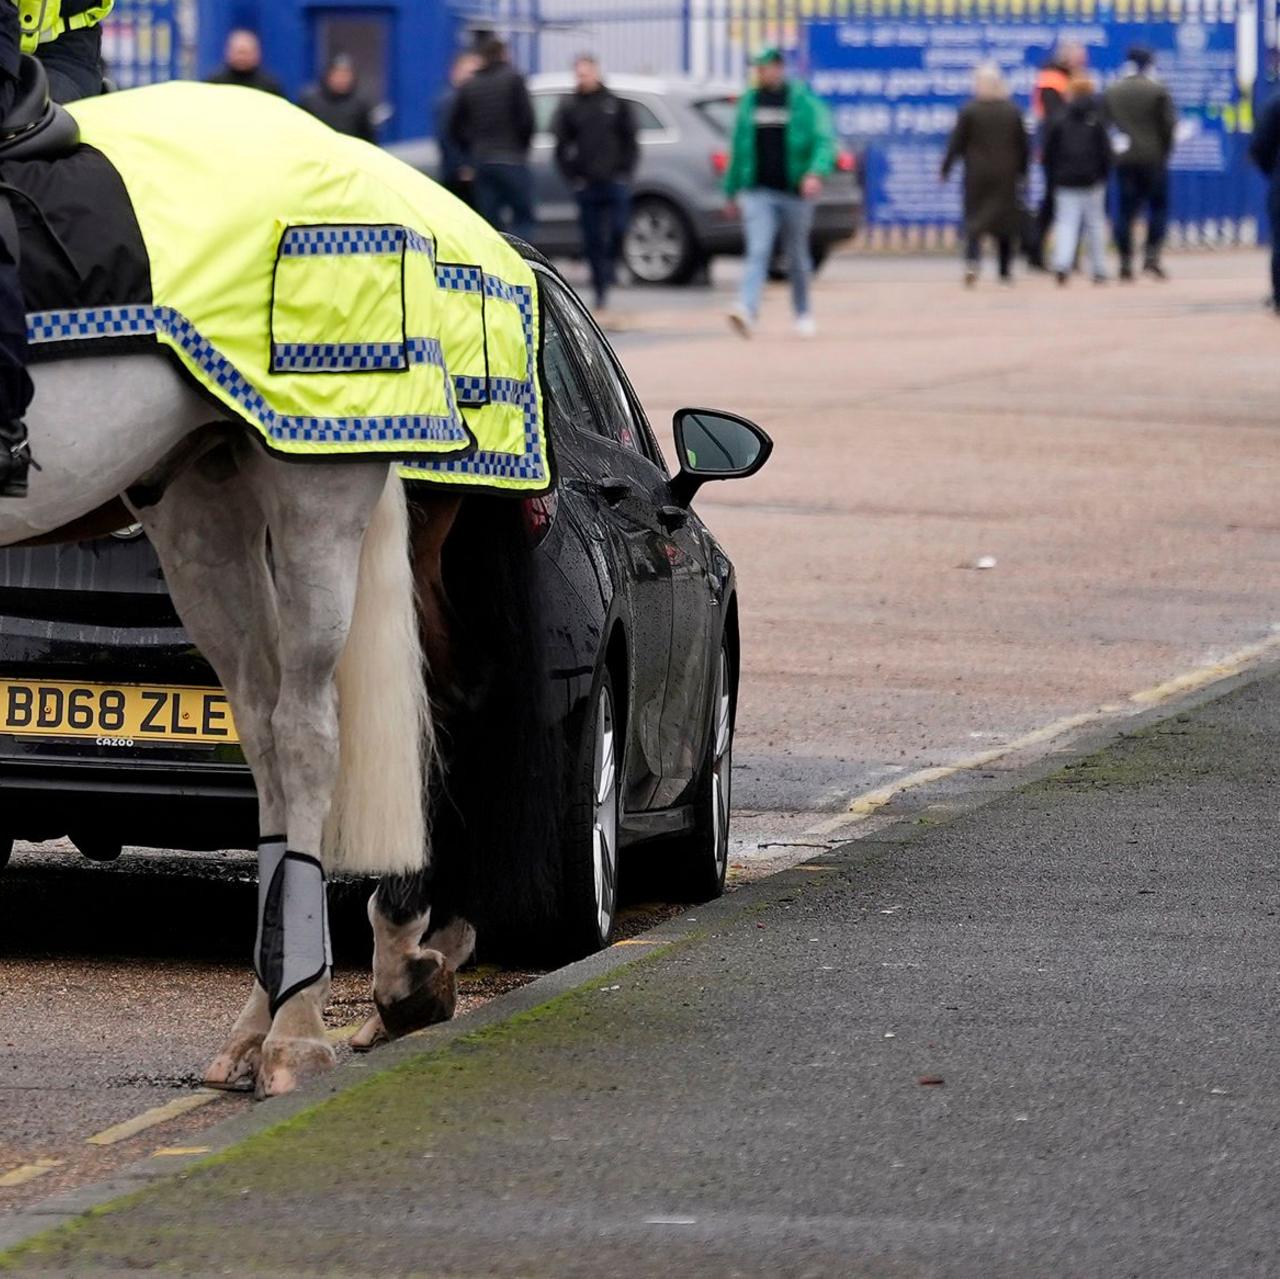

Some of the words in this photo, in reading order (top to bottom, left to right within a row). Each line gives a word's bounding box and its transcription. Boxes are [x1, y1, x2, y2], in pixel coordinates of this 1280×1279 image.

[5, 685, 126, 731] BD68
[140, 690, 229, 736] ZLE
[96, 738, 134, 747] CAZOO
